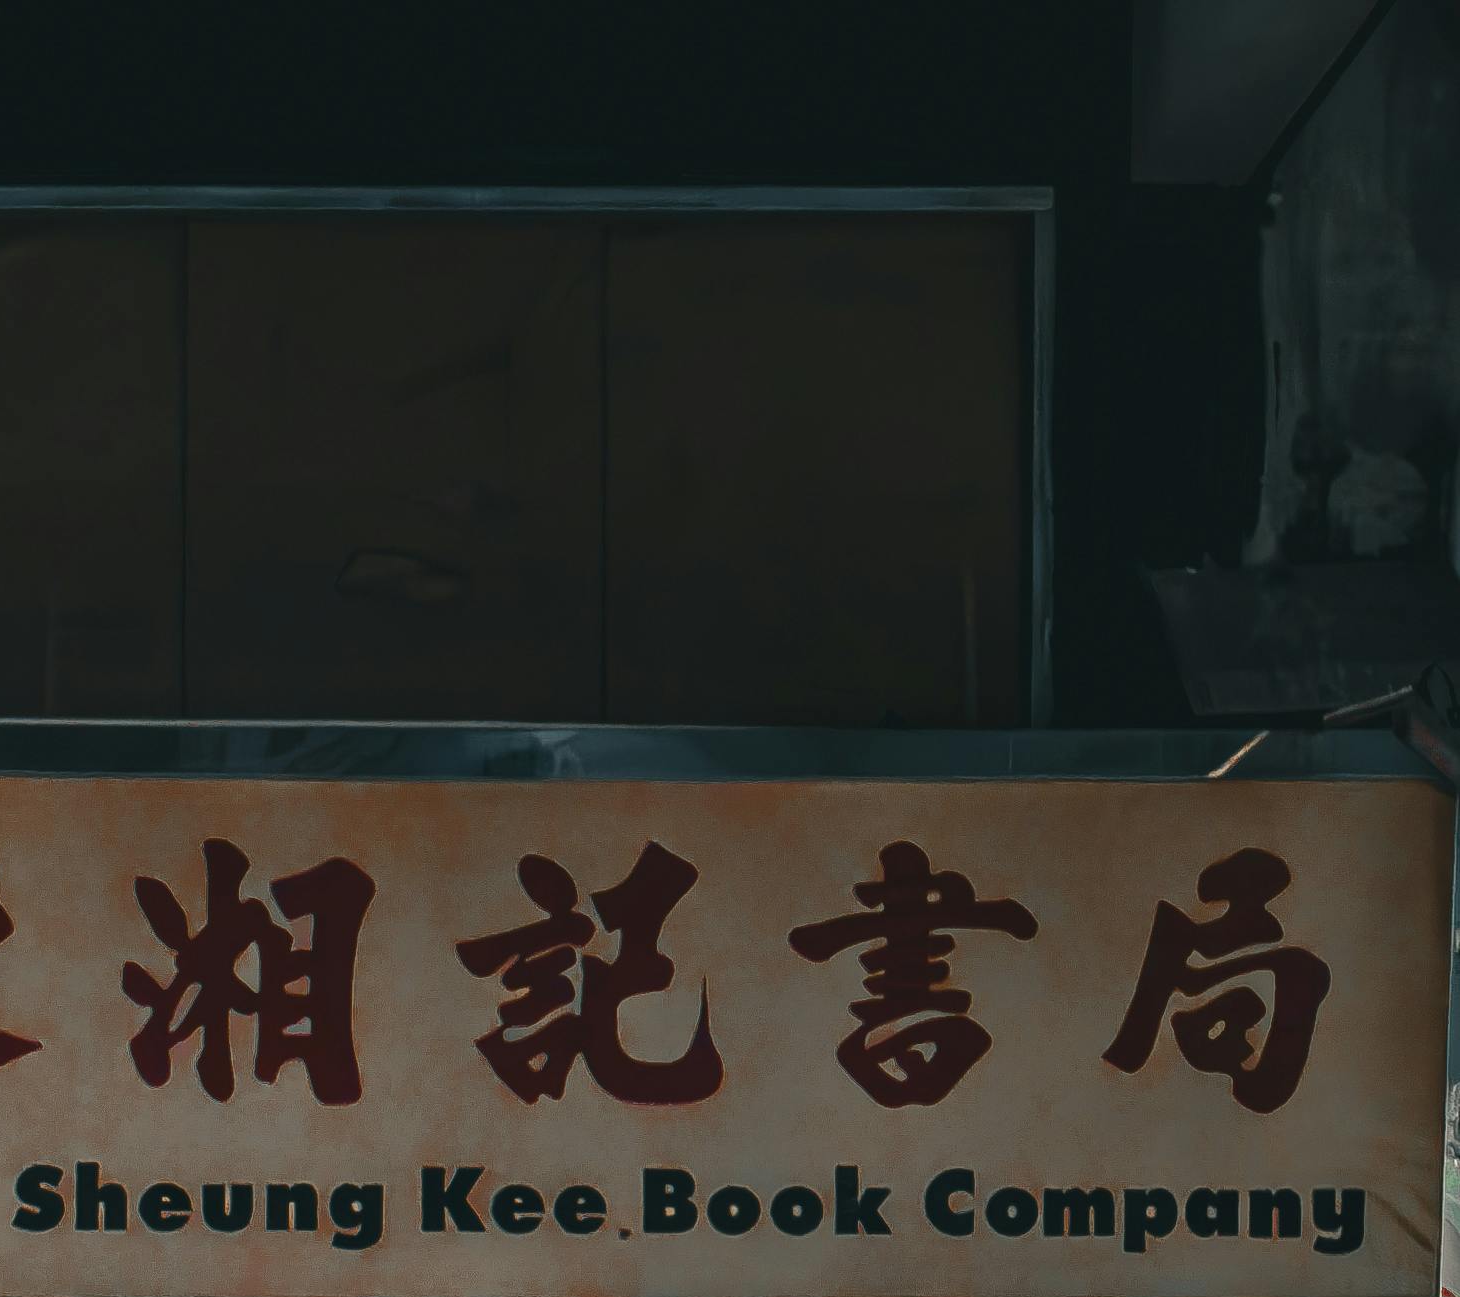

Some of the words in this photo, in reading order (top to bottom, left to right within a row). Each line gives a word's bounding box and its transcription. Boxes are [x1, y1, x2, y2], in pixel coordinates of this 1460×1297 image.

[11, 1160, 385, 1252] Sheung
[641, 1164, 893, 1238] Book
[924, 1167, 1368, 1256] Company
